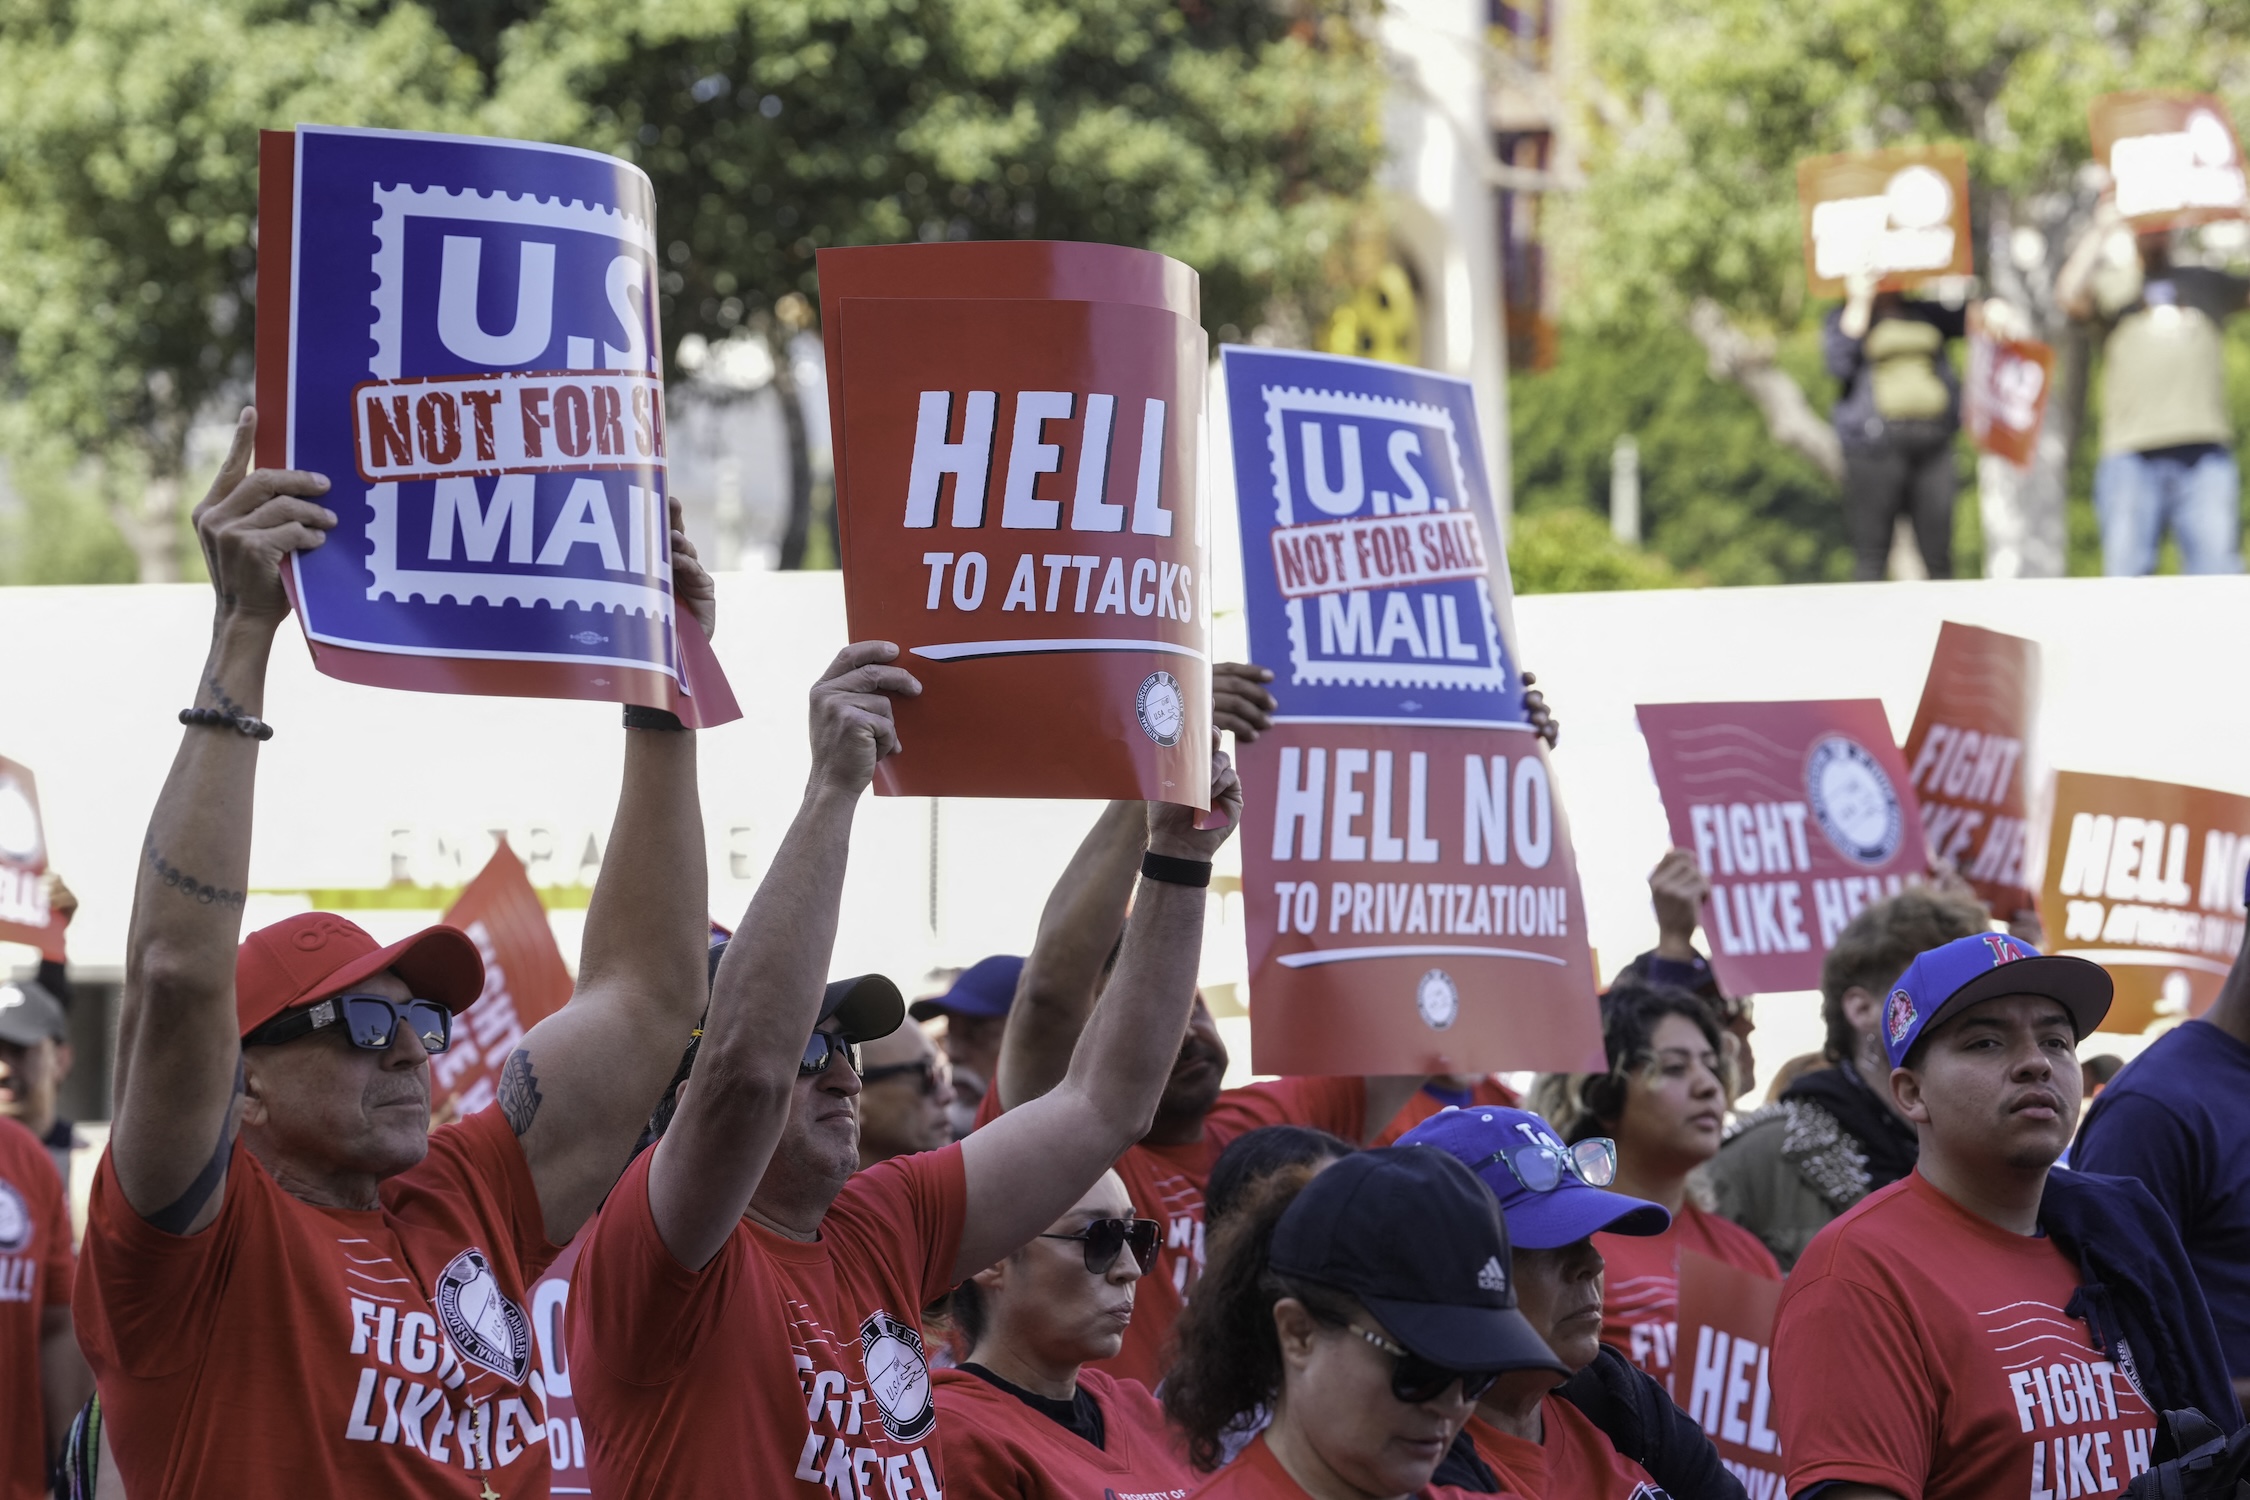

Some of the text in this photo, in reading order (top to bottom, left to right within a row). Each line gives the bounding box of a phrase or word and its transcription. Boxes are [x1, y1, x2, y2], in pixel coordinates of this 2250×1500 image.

[365, 389, 503, 468] NOT
[519, 383, 626, 459] FOR
[903, 391, 1173, 537] HELL
[1301, 421, 1450, 516] U.S.
[427, 475, 671, 582] MAIL
[1279, 518, 1484, 589] NOT FOR SALE
[923, 552, 988, 611] TO
[1002, 554, 1192, 624] ATTACKS
[1318, 590, 1479, 661] MAIL
[1909, 723, 2021, 805] FIGHT
[1271, 747, 1553, 869] HELL NO
[1690, 802, 1811, 877] FIGHT
[2059, 812, 2191, 905] HELL
[1274, 881, 1568, 938] TO PRIVATIZATION!
[1711, 880, 1811, 956] LIKE
[505, 1308, 525, 1360] CARRIERS
[891, 1323, 902, 1337] OF
[1688, 1324, 1782, 1457] HEL
[2008, 1361, 2119, 1433] FIGHT
[1170, 1489, 1186, 1499] OF
[2030, 1430, 2119, 1500] LIKE
